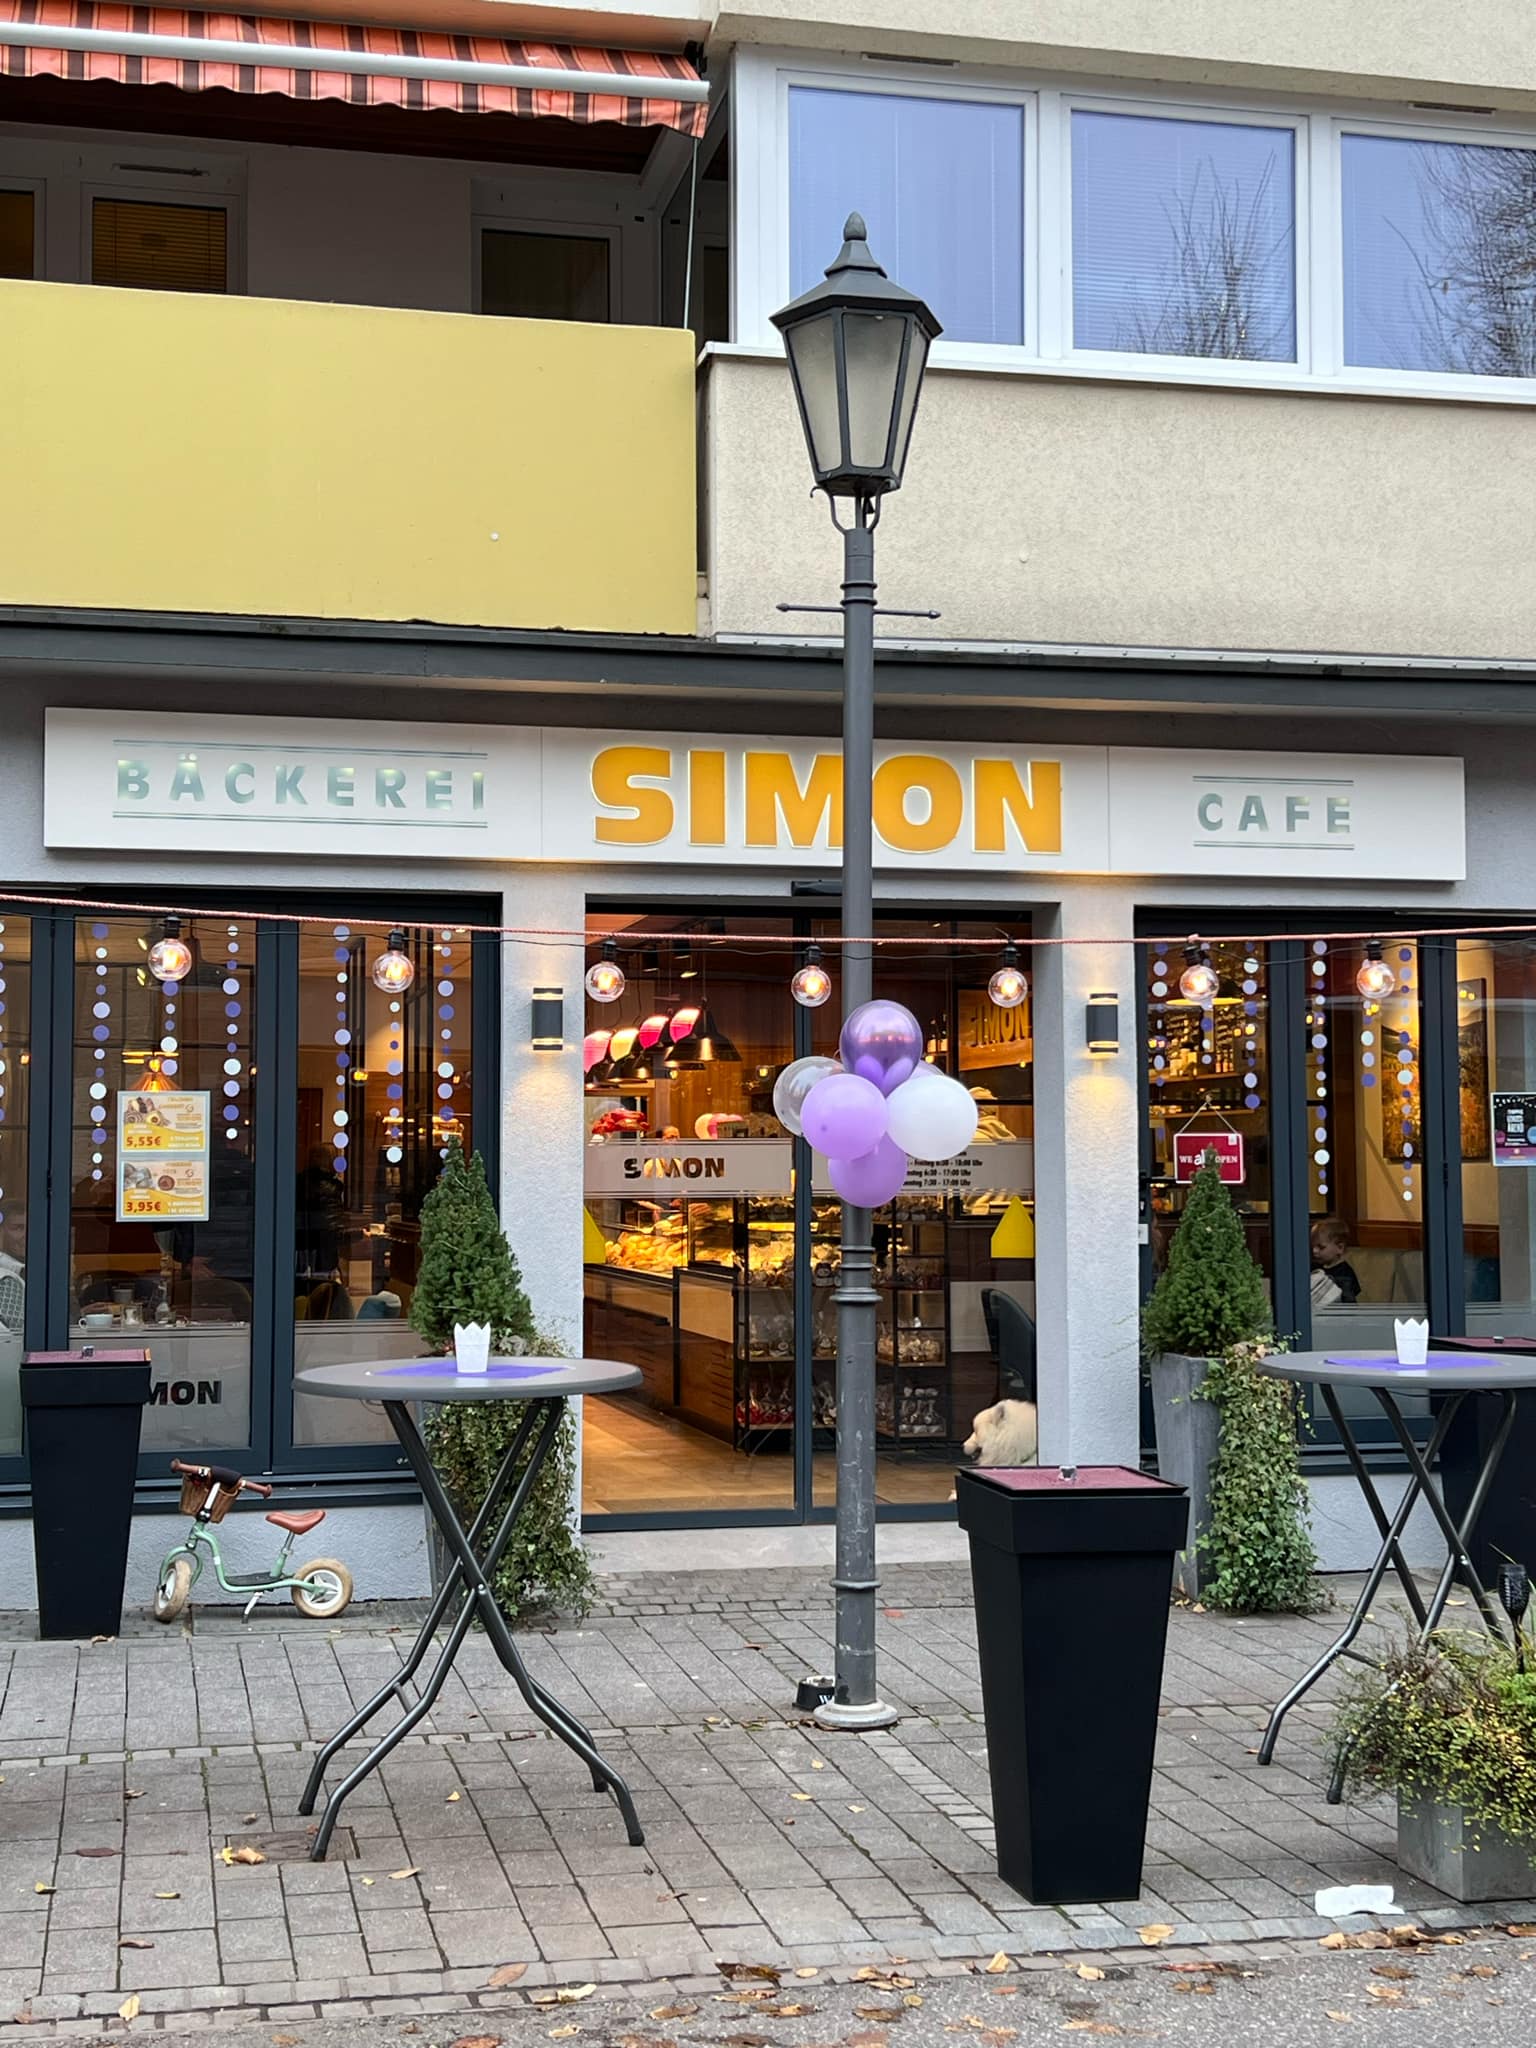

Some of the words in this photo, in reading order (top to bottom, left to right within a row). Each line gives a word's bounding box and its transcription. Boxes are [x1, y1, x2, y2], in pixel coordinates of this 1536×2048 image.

[116, 753, 485, 811] BÄCKEREI
[590, 746, 1063, 856] SIMON
[1197, 793, 1351, 834] CAFE
[126, 1136, 160, 1147] 5,55€
[624, 1157, 725, 1179] SIMON
[1179, 1155, 1193, 1164] WE
[1215, 1155, 1238, 1164] OPEN
[126, 1201, 160, 1213] 3,95€
[149, 1381, 222, 1405] MON
